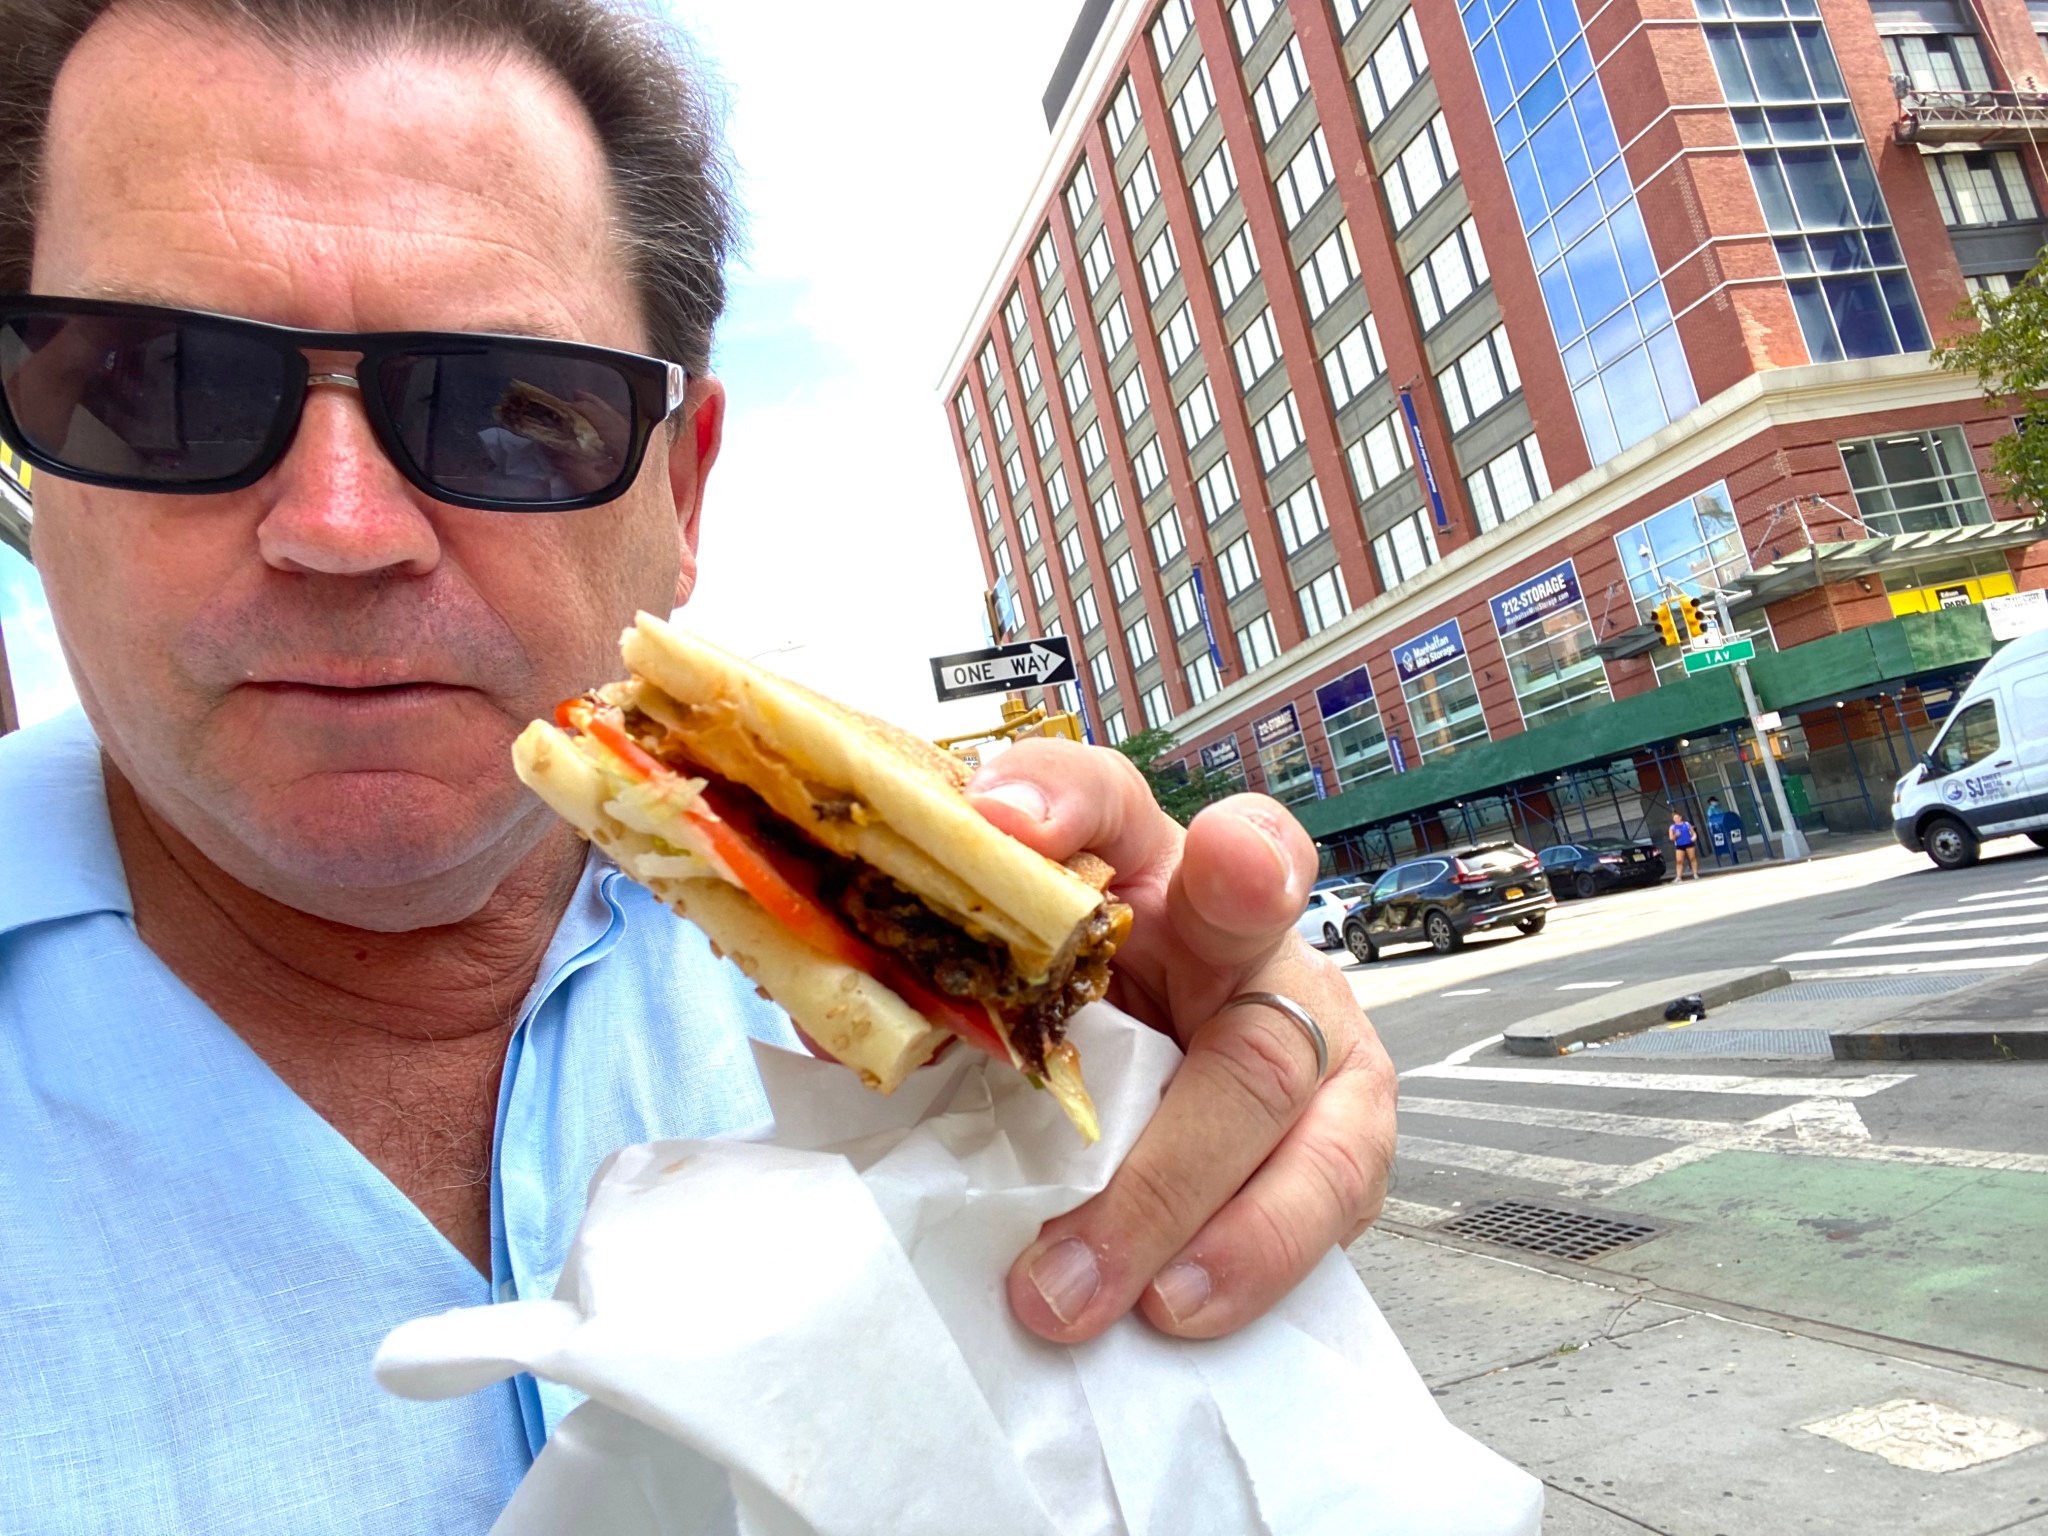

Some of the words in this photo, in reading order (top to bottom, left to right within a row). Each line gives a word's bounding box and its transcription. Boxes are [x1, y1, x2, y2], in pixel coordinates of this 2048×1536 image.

[1501, 573, 1567, 617] 212-STORAGE
[1412, 634, 1450, 659] Manhattan
[1416, 654, 1431, 669] Mini
[1429, 644, 1457, 663] Storage
[1705, 653, 1711, 664] 1
[1714, 650, 1730, 663] Av
[953, 662, 995, 685] ONE
[1010, 653, 1050, 676] WAY
